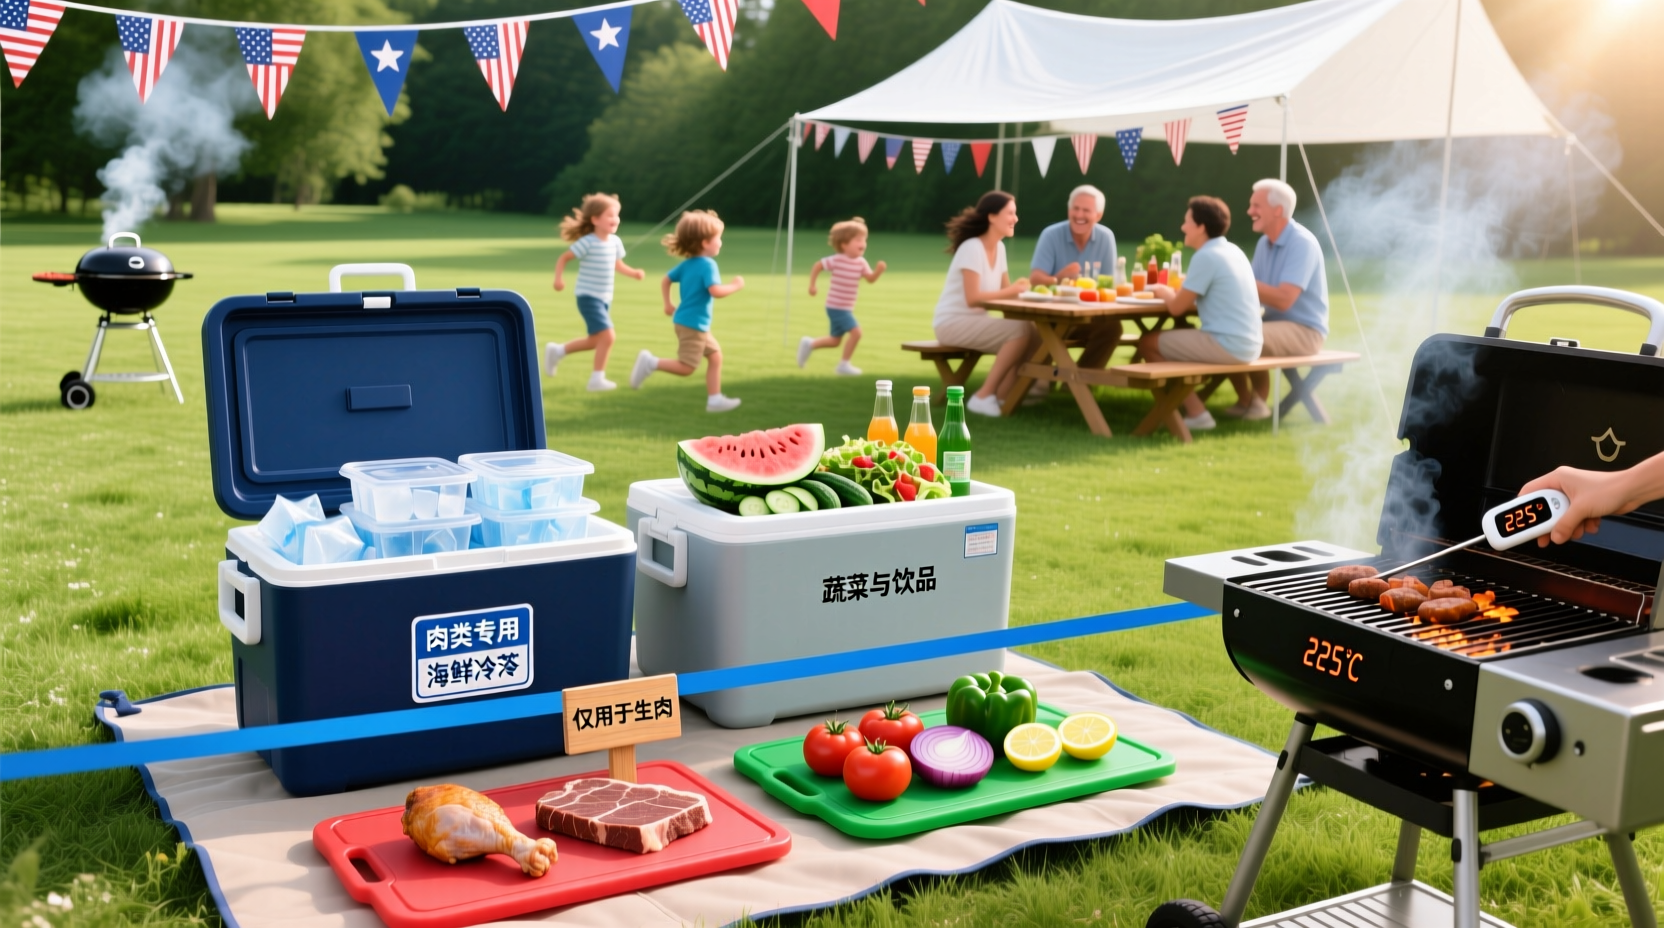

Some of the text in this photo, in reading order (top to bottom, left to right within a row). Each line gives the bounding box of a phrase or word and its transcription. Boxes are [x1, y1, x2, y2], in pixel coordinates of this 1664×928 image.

[822, 565, 936, 603] 蔬菜与饮品
[426, 617, 519, 652] 肉类专用
[572, 696, 673, 731] 仅用于生肉
